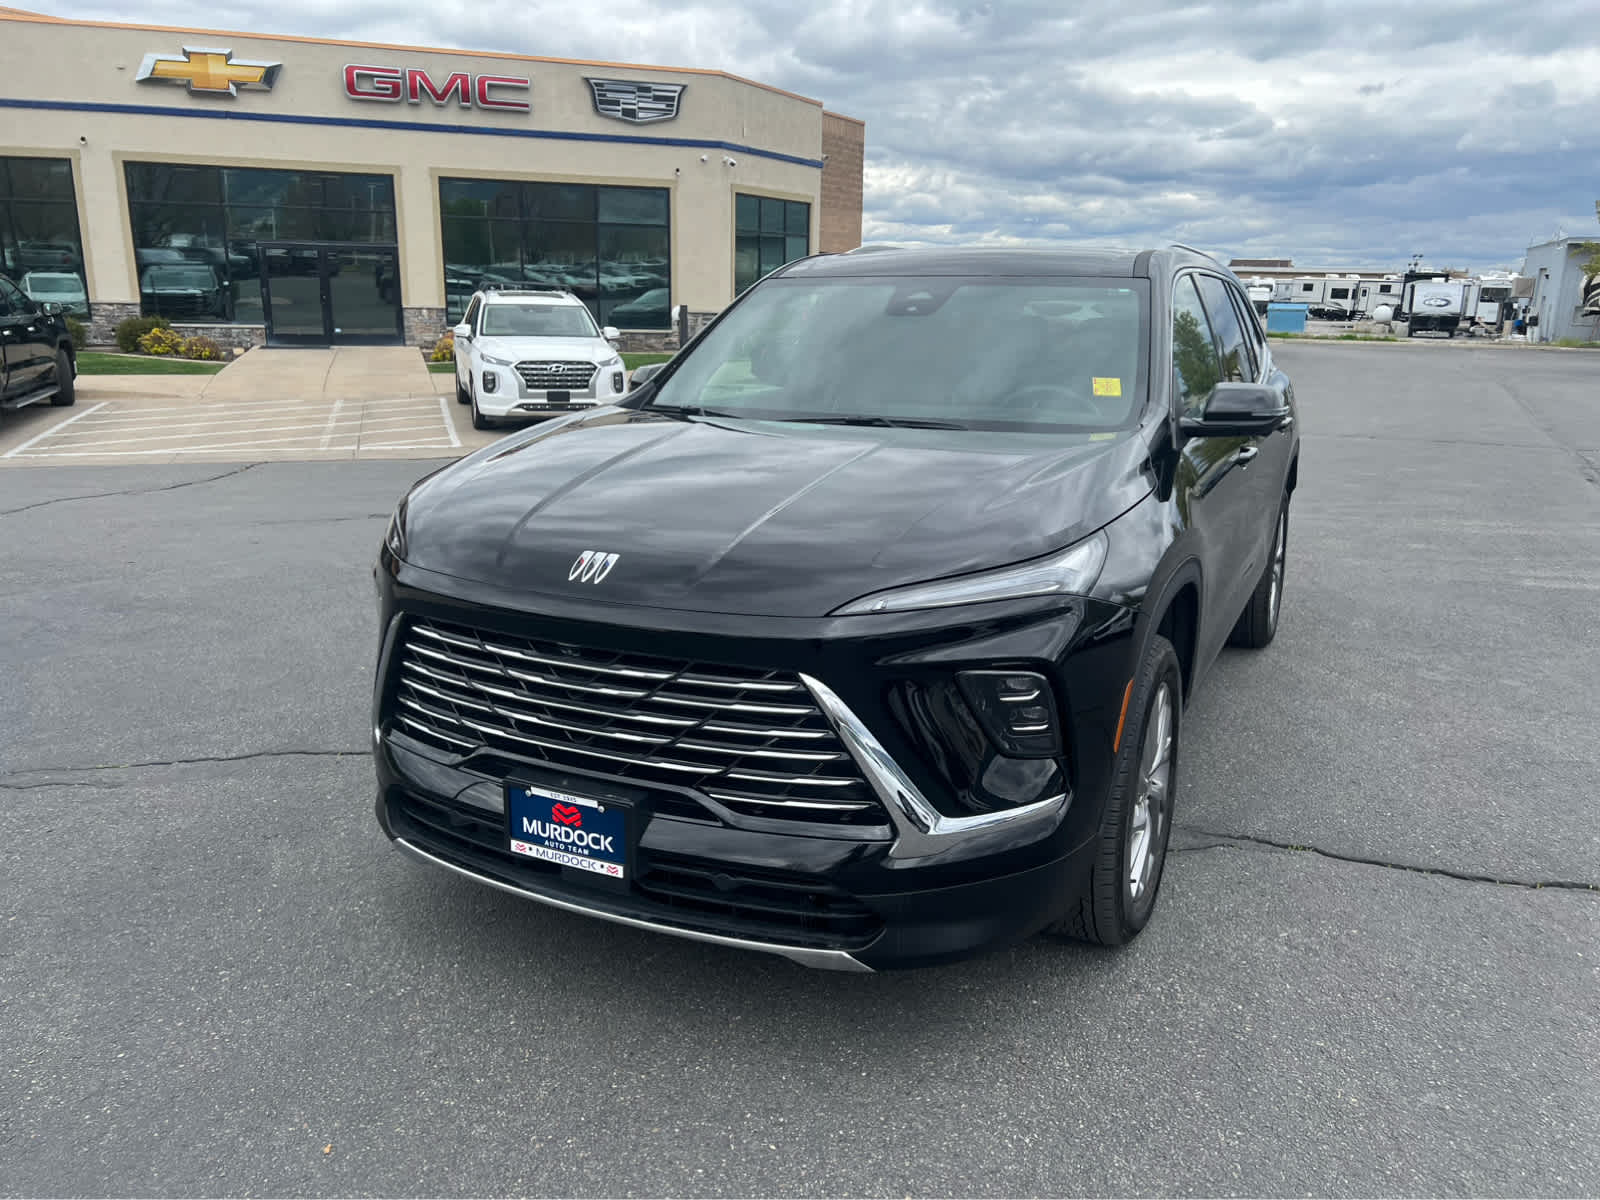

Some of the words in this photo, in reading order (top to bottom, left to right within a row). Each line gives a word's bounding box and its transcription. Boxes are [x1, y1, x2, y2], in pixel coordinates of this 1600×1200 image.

[343, 64, 532, 112] GMC
[522, 816, 614, 853] MURDOCK
[544, 840, 565, 850] AUTO
[568, 845, 590, 855] TEAM
[536, 848, 597, 870] MURDOCK
